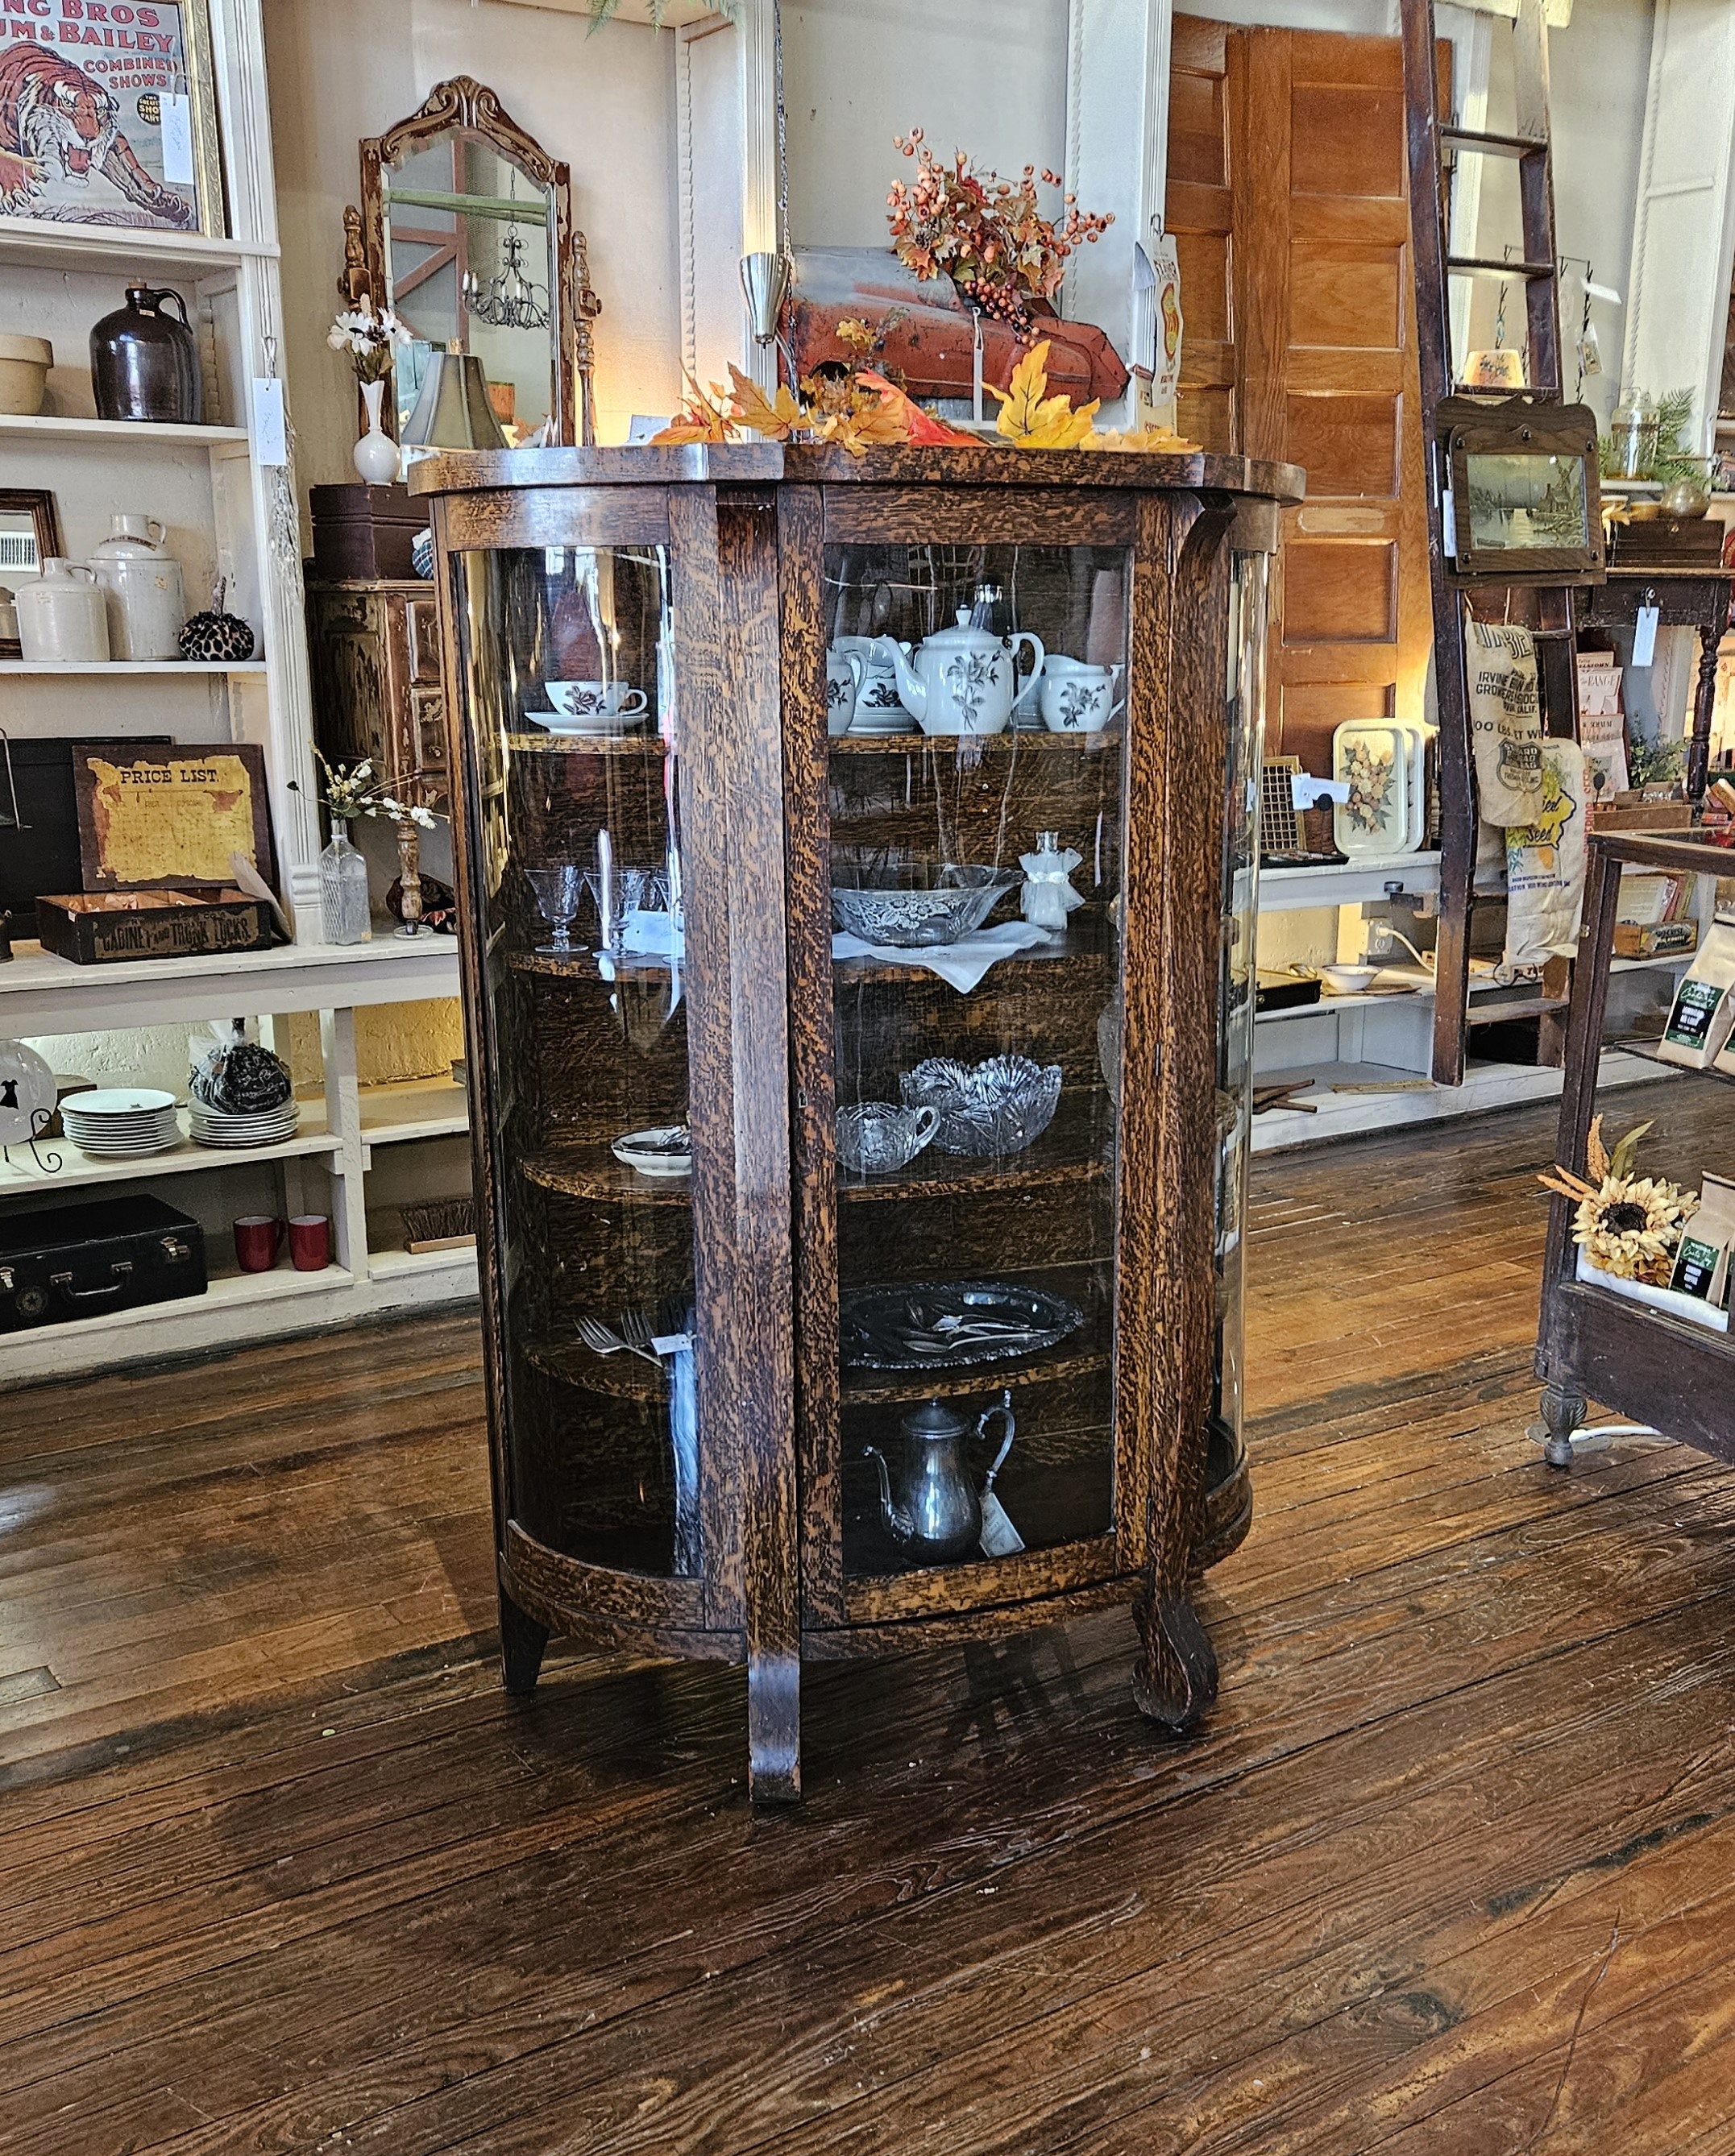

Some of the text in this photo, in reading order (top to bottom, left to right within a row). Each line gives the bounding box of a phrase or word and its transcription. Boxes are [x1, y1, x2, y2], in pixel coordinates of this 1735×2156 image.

[62, 0, 160, 27] BROS
[40, 25, 56, 41] &
[57, 20, 175, 53] BAILEY
[109, 73, 167, 89] SHOWS
[139, 105, 160, 114] SHO
[120, 769, 220, 784] PRICE LIST.
